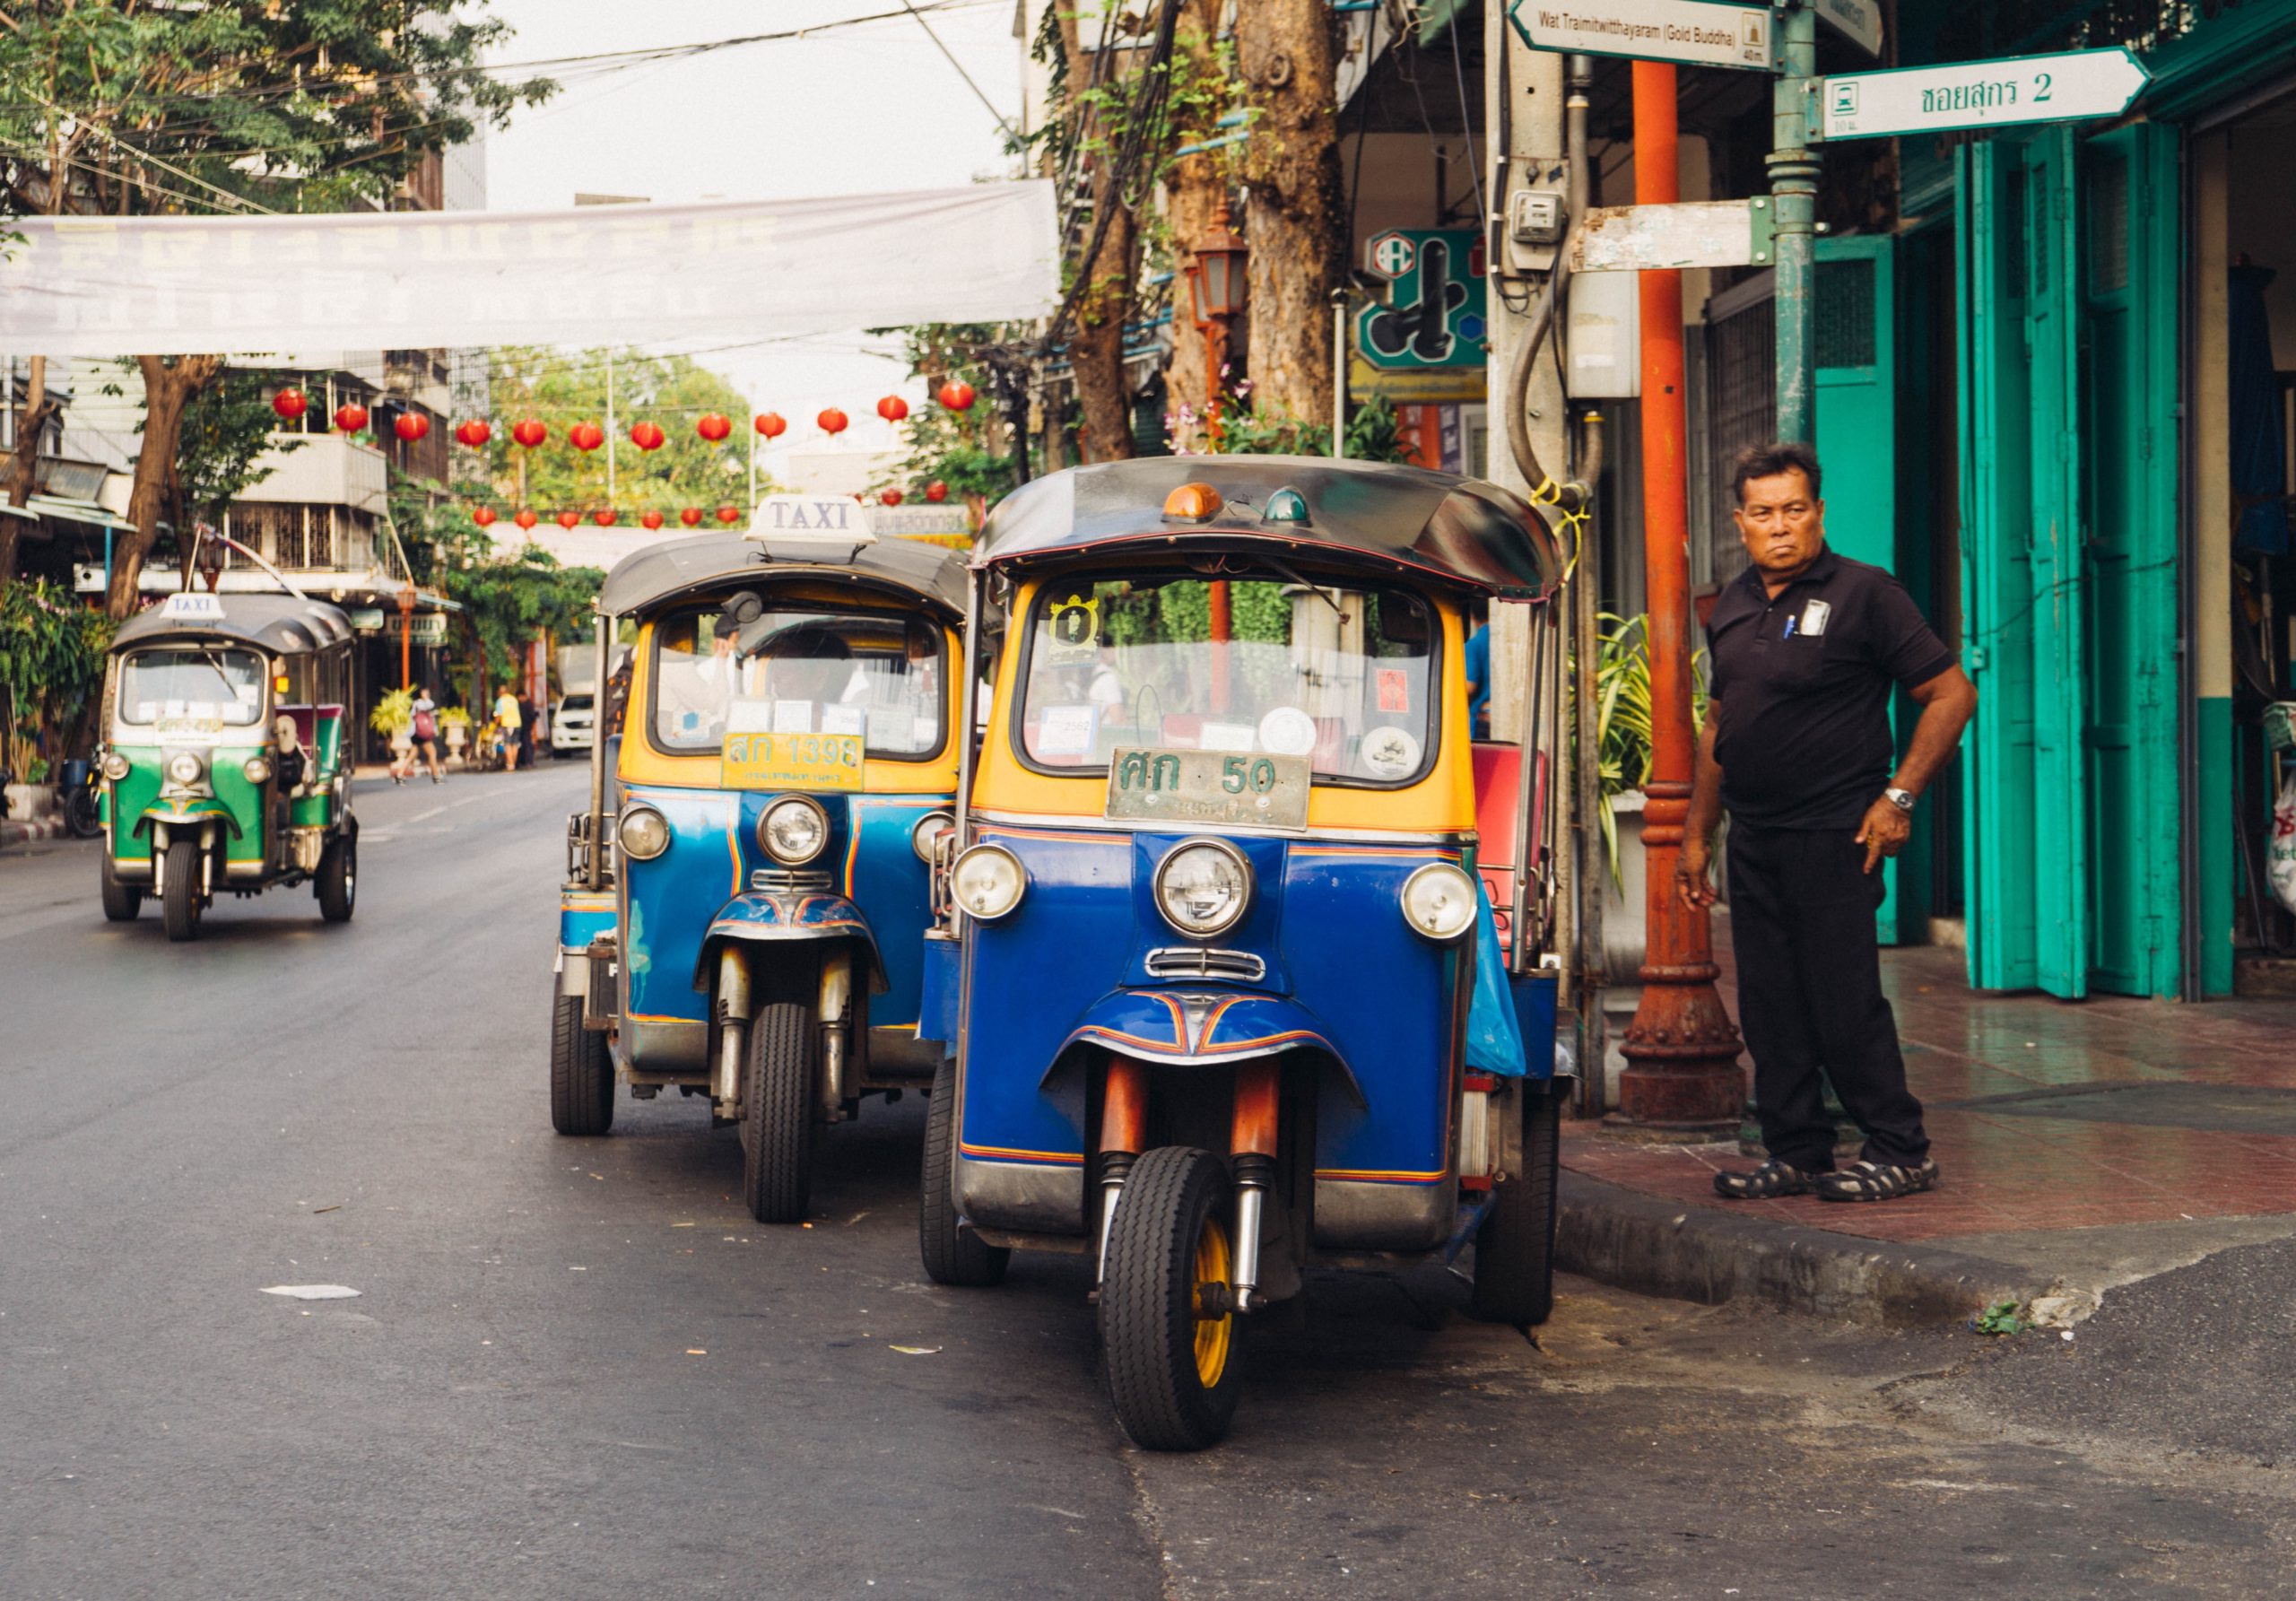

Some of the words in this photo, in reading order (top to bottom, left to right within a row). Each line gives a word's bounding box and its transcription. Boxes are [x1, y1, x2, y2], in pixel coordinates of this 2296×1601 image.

[1538, 10, 1561, 29] Wat
[1562, 13, 1660, 40] Traimitwitthayaram
[1663, 23, 1691, 44] (Gold
[1693, 27, 1737, 49] Buddha)
[2033, 73, 2053, 101] 2
[770, 501, 851, 530] TAXI
[172, 598, 211, 612] TAXI
[789, 738, 857, 768] 1398
[1222, 755, 1276, 795] 50
